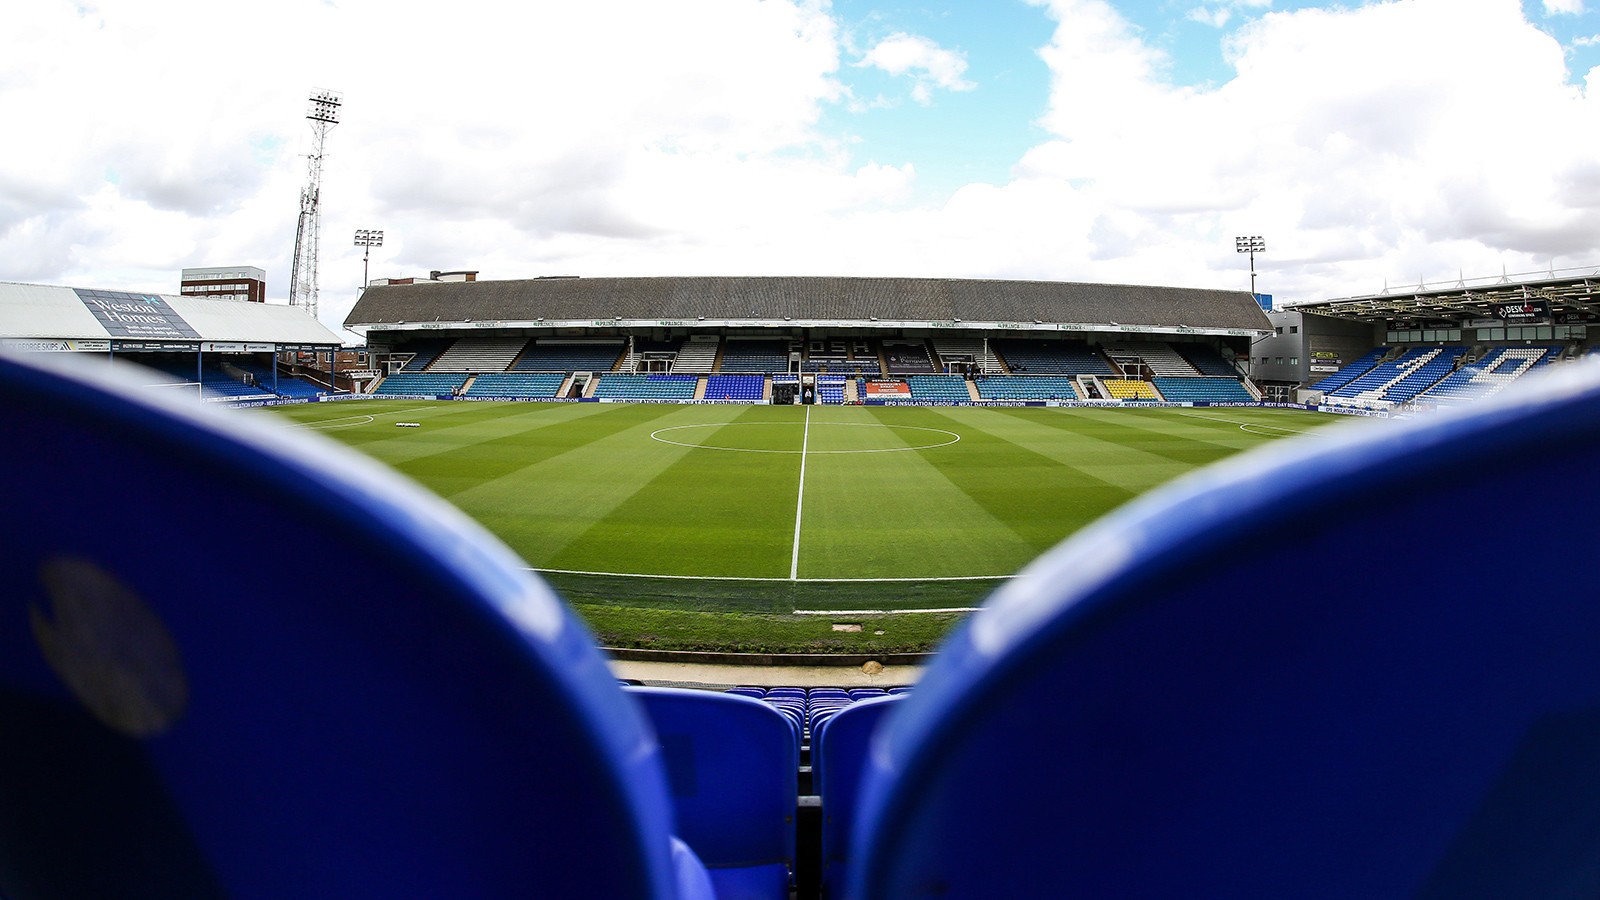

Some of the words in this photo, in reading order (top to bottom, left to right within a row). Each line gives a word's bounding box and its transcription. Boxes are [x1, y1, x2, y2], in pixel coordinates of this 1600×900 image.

[91, 299, 157, 313] Weston
[103, 310, 167, 324] Homes
[18, 343, 40, 351] GEORGE
[41, 343, 58, 351] SKIPS
[1333, 407, 1354, 415] INSULATION
